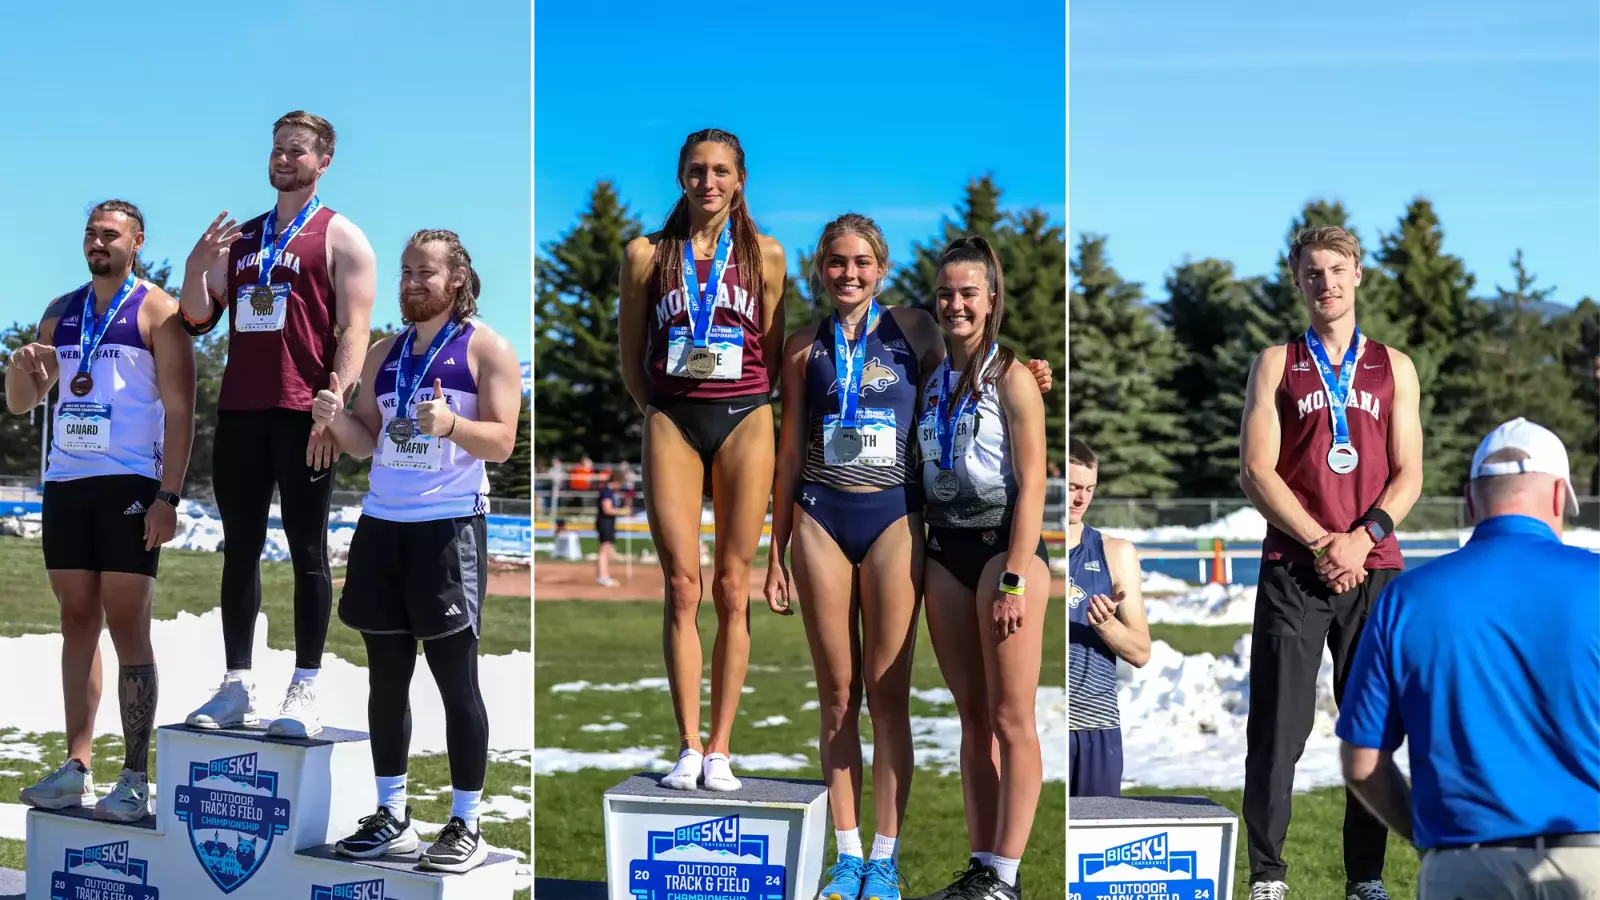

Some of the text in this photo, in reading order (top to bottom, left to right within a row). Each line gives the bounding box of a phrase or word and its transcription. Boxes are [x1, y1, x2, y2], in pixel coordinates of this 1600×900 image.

[235, 251, 300, 276] MOANA
[655, 282, 755, 330] MOANA
[60, 350, 83, 360] WEB
[382, 392, 453, 409] WER STE
[1297, 388, 1381, 421] MOANA
[66, 423, 99, 436] CANARD
[923, 422, 967, 442] SYLER
[395, 442, 430, 455] TRAFNY
[178, 794, 190, 804] 20
[210, 791, 254, 807] OUTDOOR
[200, 800, 264, 821] TRACK & FIELD
[273, 807, 287, 817] 24
[200, 815, 261, 832] CHAMPIONSHIP
[634, 869, 650, 881] 20
[678, 864, 738, 878] OUTDOOR
[54, 880, 66, 890] 20
[84, 878, 126, 894] OUTDOOR
[664, 874, 750, 894] TRACK & FIELD
[765, 875, 781, 887] 24
[75, 885, 102, 900] TRACK
[1109, 882, 1168, 895] OUTDOOR
[1194, 888, 1210, 899] 24
